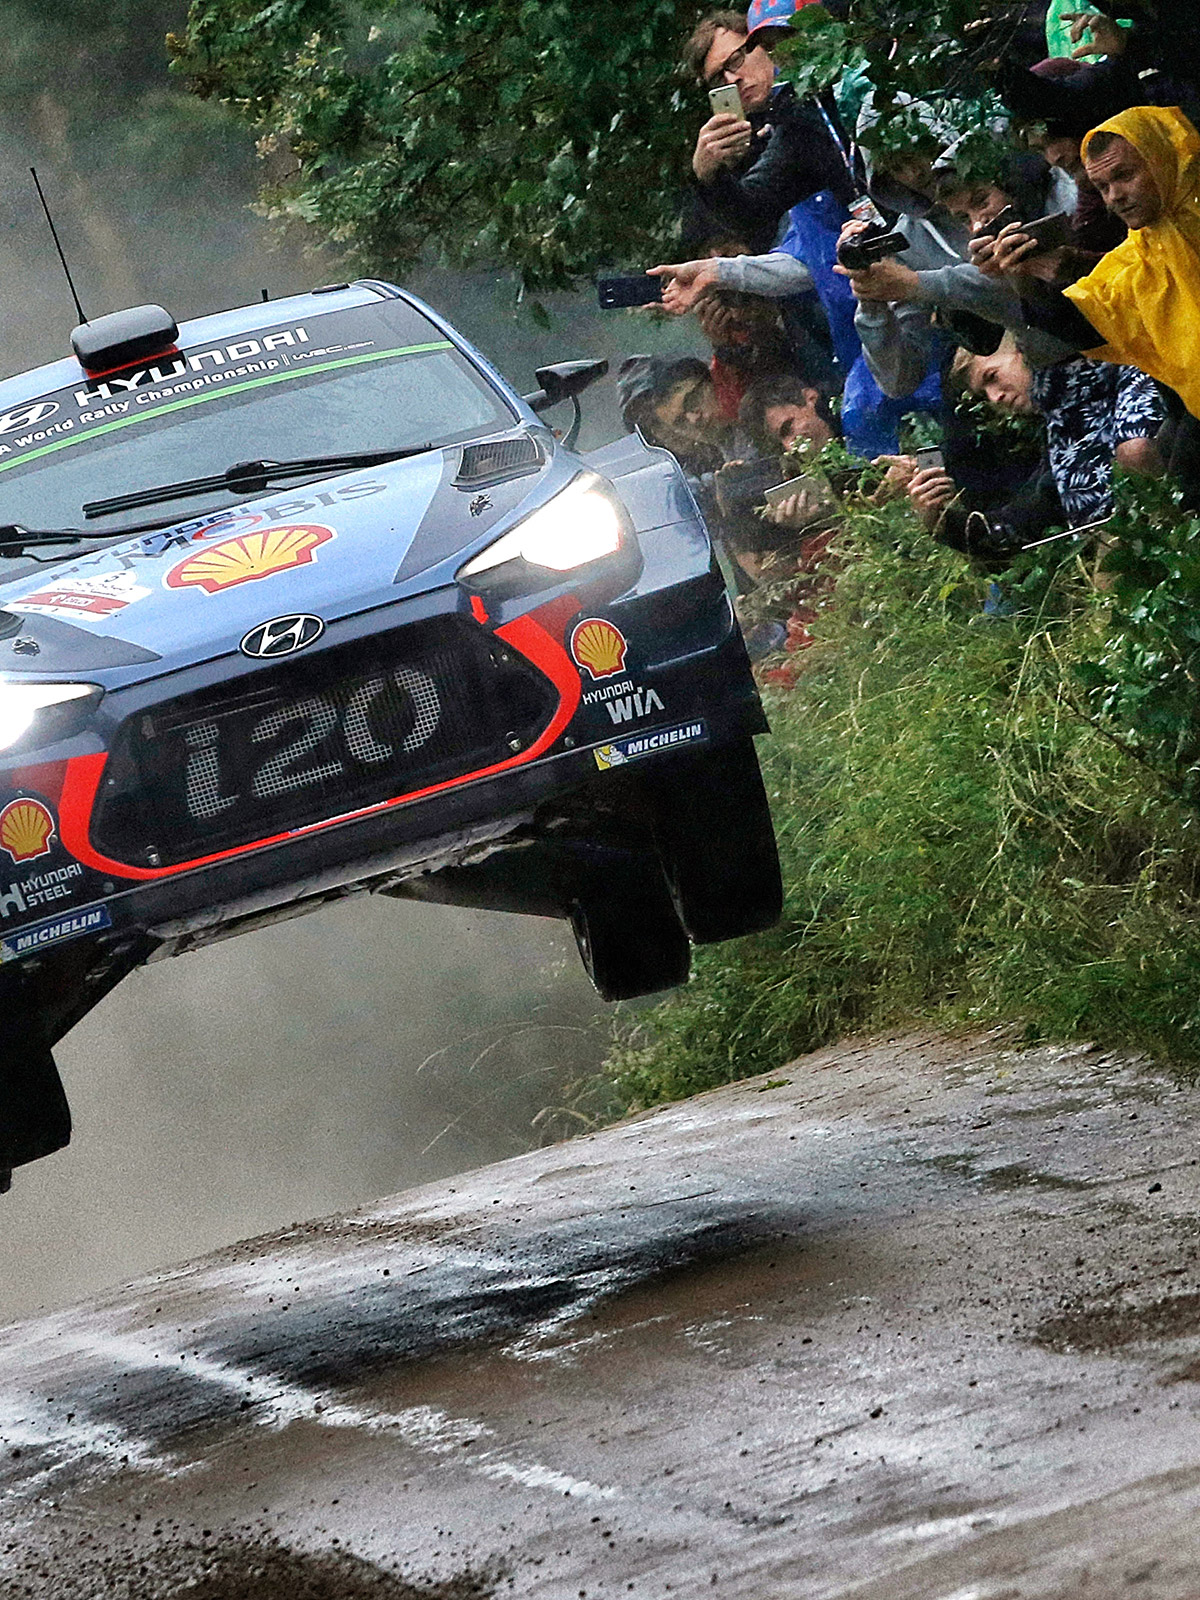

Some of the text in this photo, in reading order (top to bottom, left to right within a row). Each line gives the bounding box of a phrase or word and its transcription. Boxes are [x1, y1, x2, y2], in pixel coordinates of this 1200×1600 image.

[73, 326, 310, 407] HYUNDAI
[14, 418, 74, 447] World
[79, 400, 131, 424] Rally
[135, 357, 280, 406] Championship
[581, 680, 635, 706] HYUNDAI
[627, 723, 702, 755] MICHELIN
[20, 863, 84, 896] HYUNDAI
[26, 884, 73, 908] STEEL
[16, 911, 102, 950] MICHELIN
